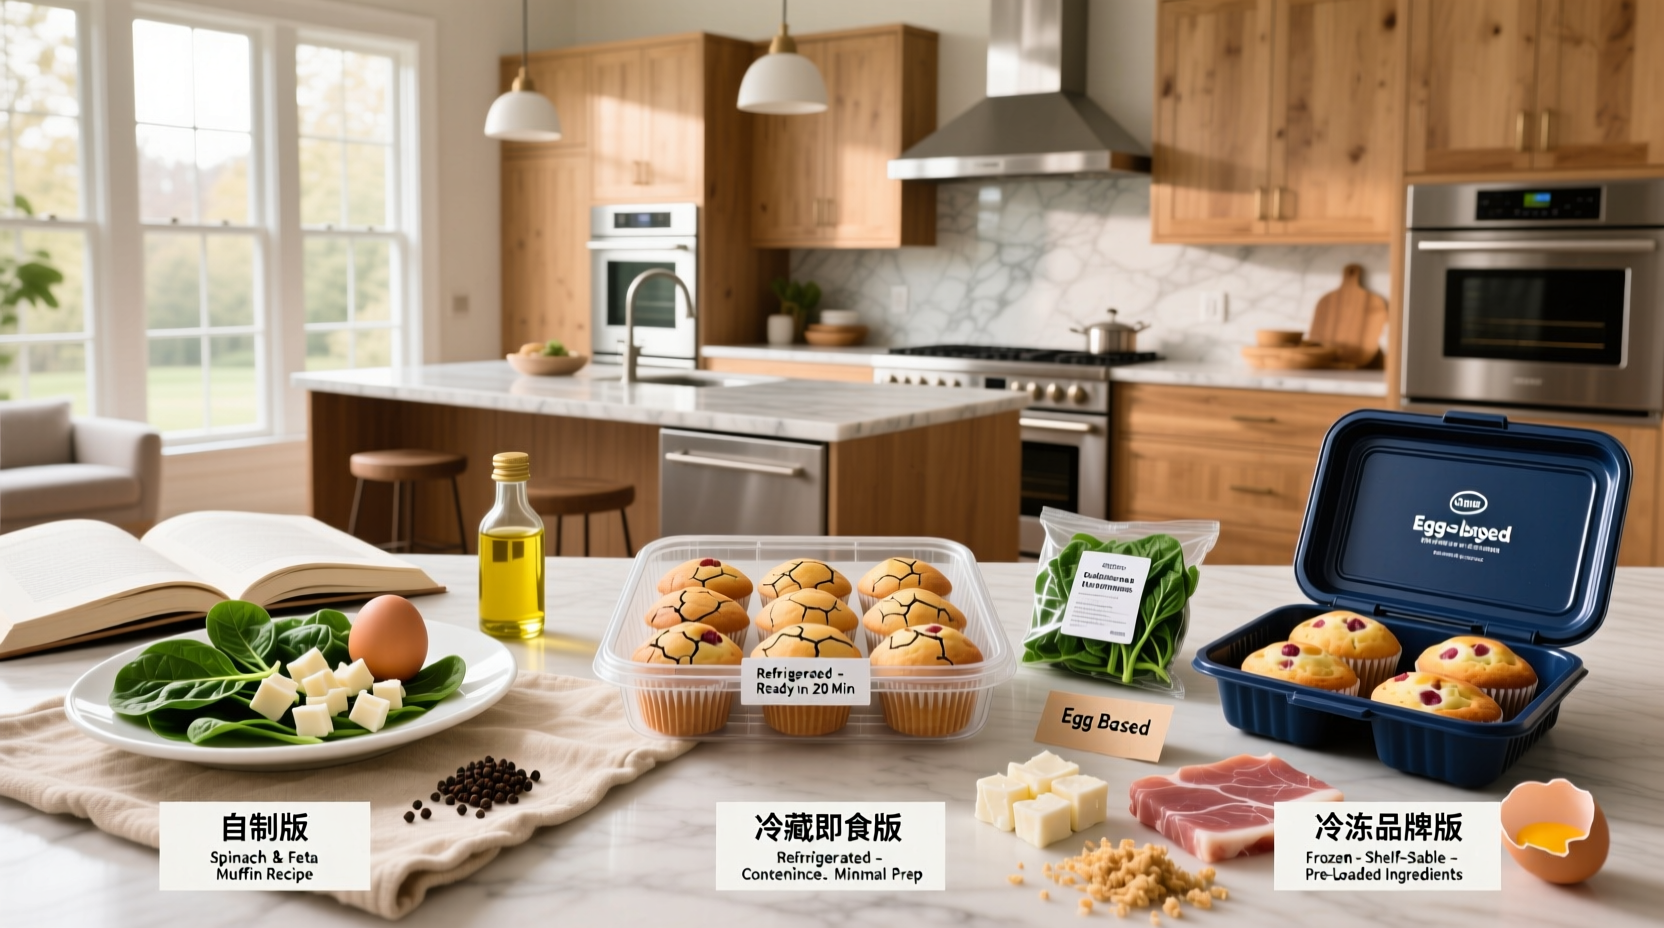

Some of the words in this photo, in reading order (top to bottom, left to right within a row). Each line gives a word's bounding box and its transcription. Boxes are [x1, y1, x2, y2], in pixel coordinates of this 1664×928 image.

[756, 682, 794, 697] Ready
[812, 682, 829, 695] 20
[832, 682, 855, 695] Min
[1061, 707, 1094, 733] Egg
[1097, 713, 1152, 736] Based
